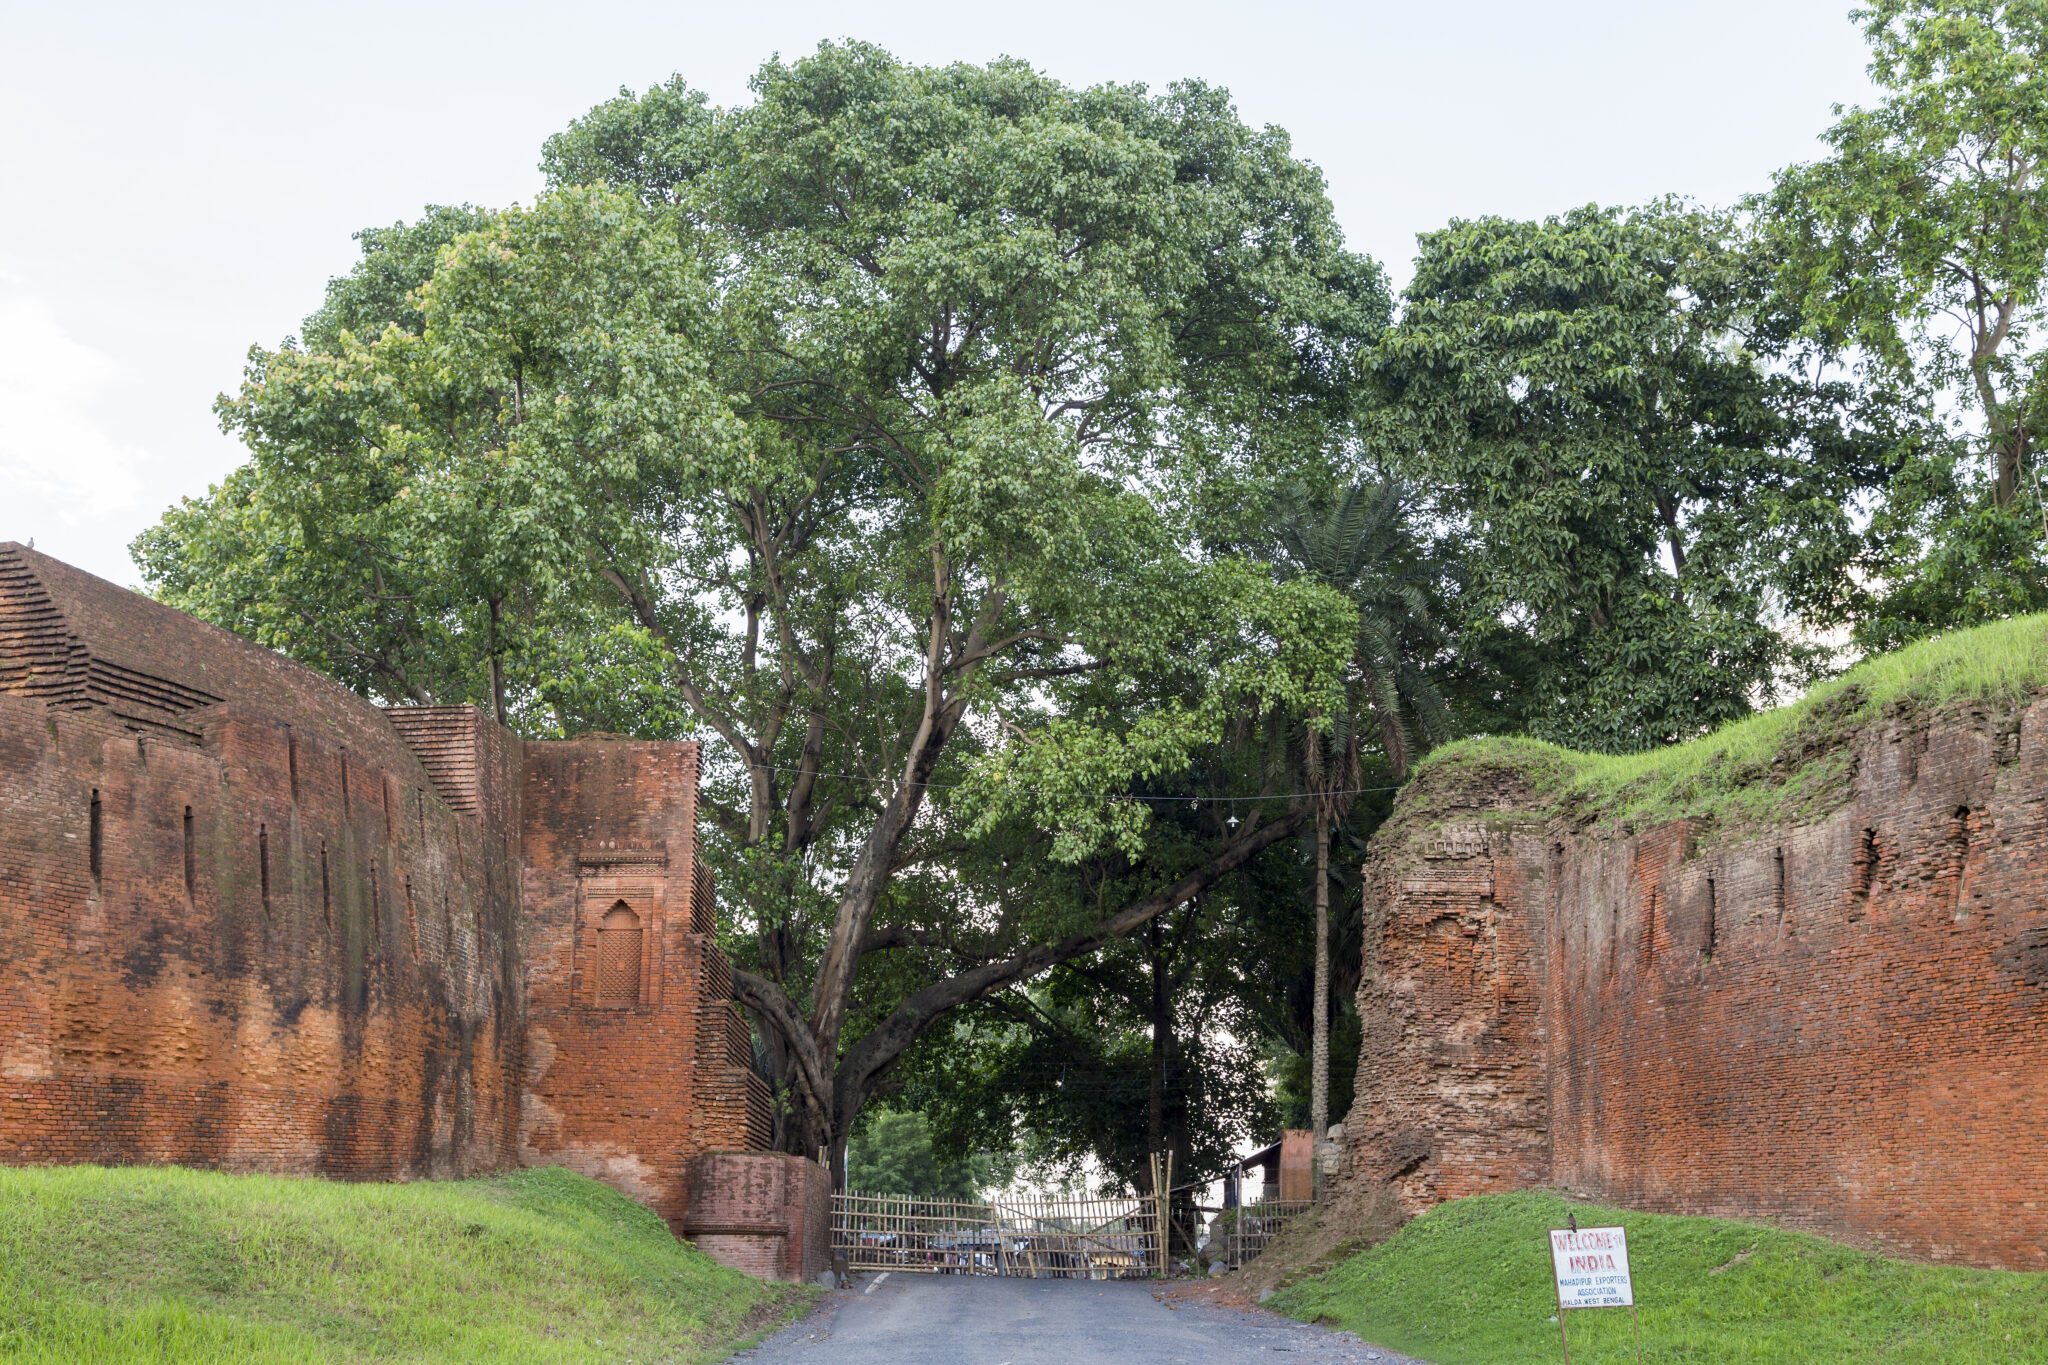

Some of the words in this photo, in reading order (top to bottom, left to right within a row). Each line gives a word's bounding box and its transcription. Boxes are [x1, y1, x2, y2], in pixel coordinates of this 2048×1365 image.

[1553, 1232, 1613, 1250] WELCOME
[1569, 1254, 1617, 1273] INDIA
[1559, 1277, 1592, 1286] MAHADIPUR
[1595, 1275, 1628, 1285] EXPORTERS
[1577, 1287, 1616, 1296] ASSOCIATION
[1583, 1297, 1600, 1305] WEST
